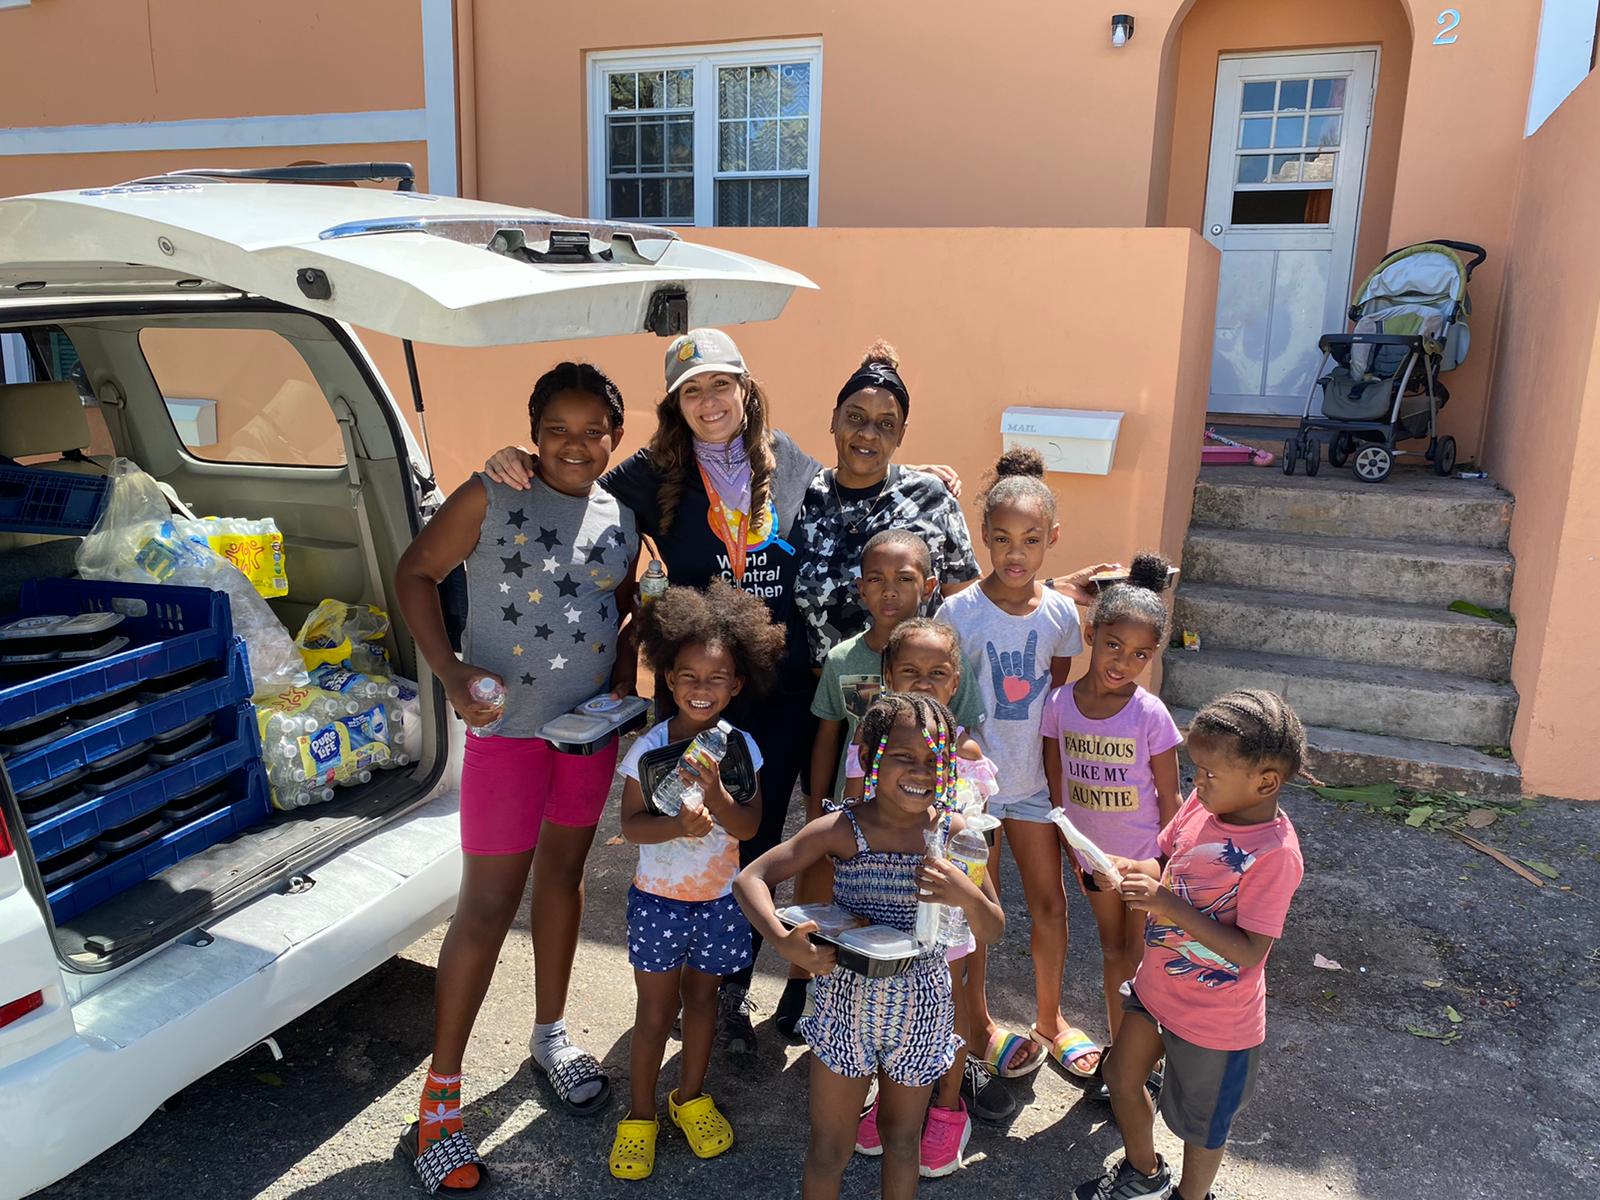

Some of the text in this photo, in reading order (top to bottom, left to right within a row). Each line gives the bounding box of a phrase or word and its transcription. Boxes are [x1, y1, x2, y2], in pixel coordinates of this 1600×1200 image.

[1432, 8, 1461, 45] 2
[1007, 423, 1037, 433] MAIL
[716, 552, 767, 570] Wrld
[720, 565, 780, 583] Cntral
[1064, 736, 1134, 758] FABULOUS
[1069, 761, 1128, 782] LIKE MY
[1072, 785, 1133, 807] AUNTIE
